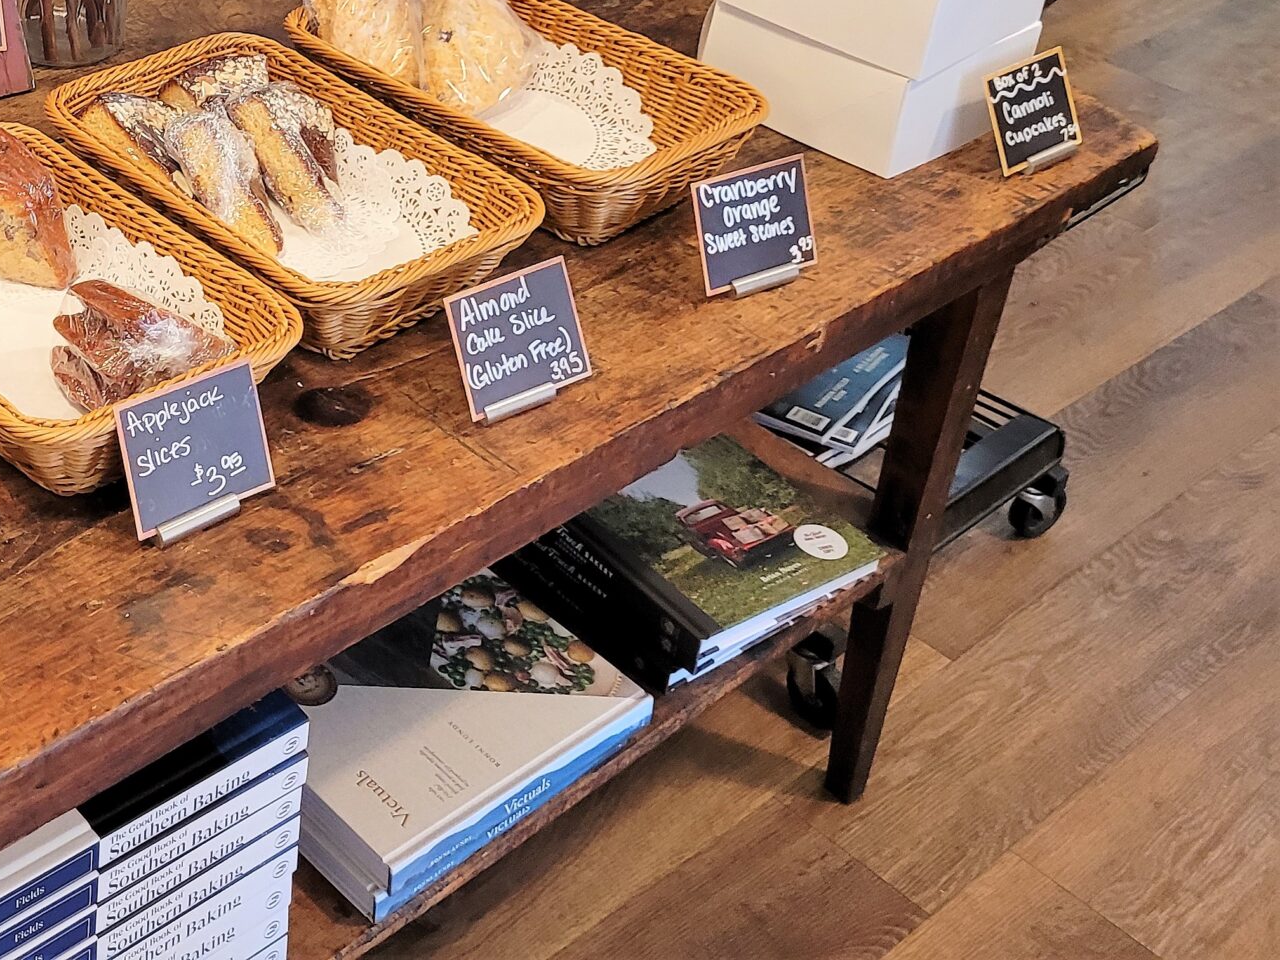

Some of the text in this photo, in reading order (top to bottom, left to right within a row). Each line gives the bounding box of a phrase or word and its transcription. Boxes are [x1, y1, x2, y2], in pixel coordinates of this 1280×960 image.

[993, 63, 1043, 91] Box of 2
[1002, 91, 1055, 125] Cannoli
[1005, 112, 1067, 146] Cupcakes
[699, 167, 797, 208] Cranberry
[723, 195, 781, 228] Orange
[703, 216, 796, 255] Sweet Scones
[459, 275, 531, 332] Almond
[466, 306, 556, 355] Cake Slice
[466, 327, 572, 390] (Gluten Free)
[126, 386, 224, 437] Applejack
[576, 574, 608, 600] BAKERY
[584, 549, 614, 579] BAKERY
[448, 720, 501, 768] RONNI LUNDY
[109, 770, 250, 859] Southern Baking
[111, 793, 189, 845] The Good Book of
[356, 769, 411, 828] Victuals
[504, 777, 552, 815] Victuals
[108, 805, 249, 894] Southern Baking
[109, 829, 188, 880] The Good Book of
[15, 885, 46, 909] Fields
[106, 835, 245, 926] Southern Baking
[107, 860, 184, 912] The Good Book of
[14, 920, 45, 944] Fields
[106, 864, 244, 958] Southern Baking
[107, 891, 184, 943] The Good Book of
[150, 930, 171, 949] Book
[173, 921, 182, 933] of
[186, 894, 242, 938] Baking
